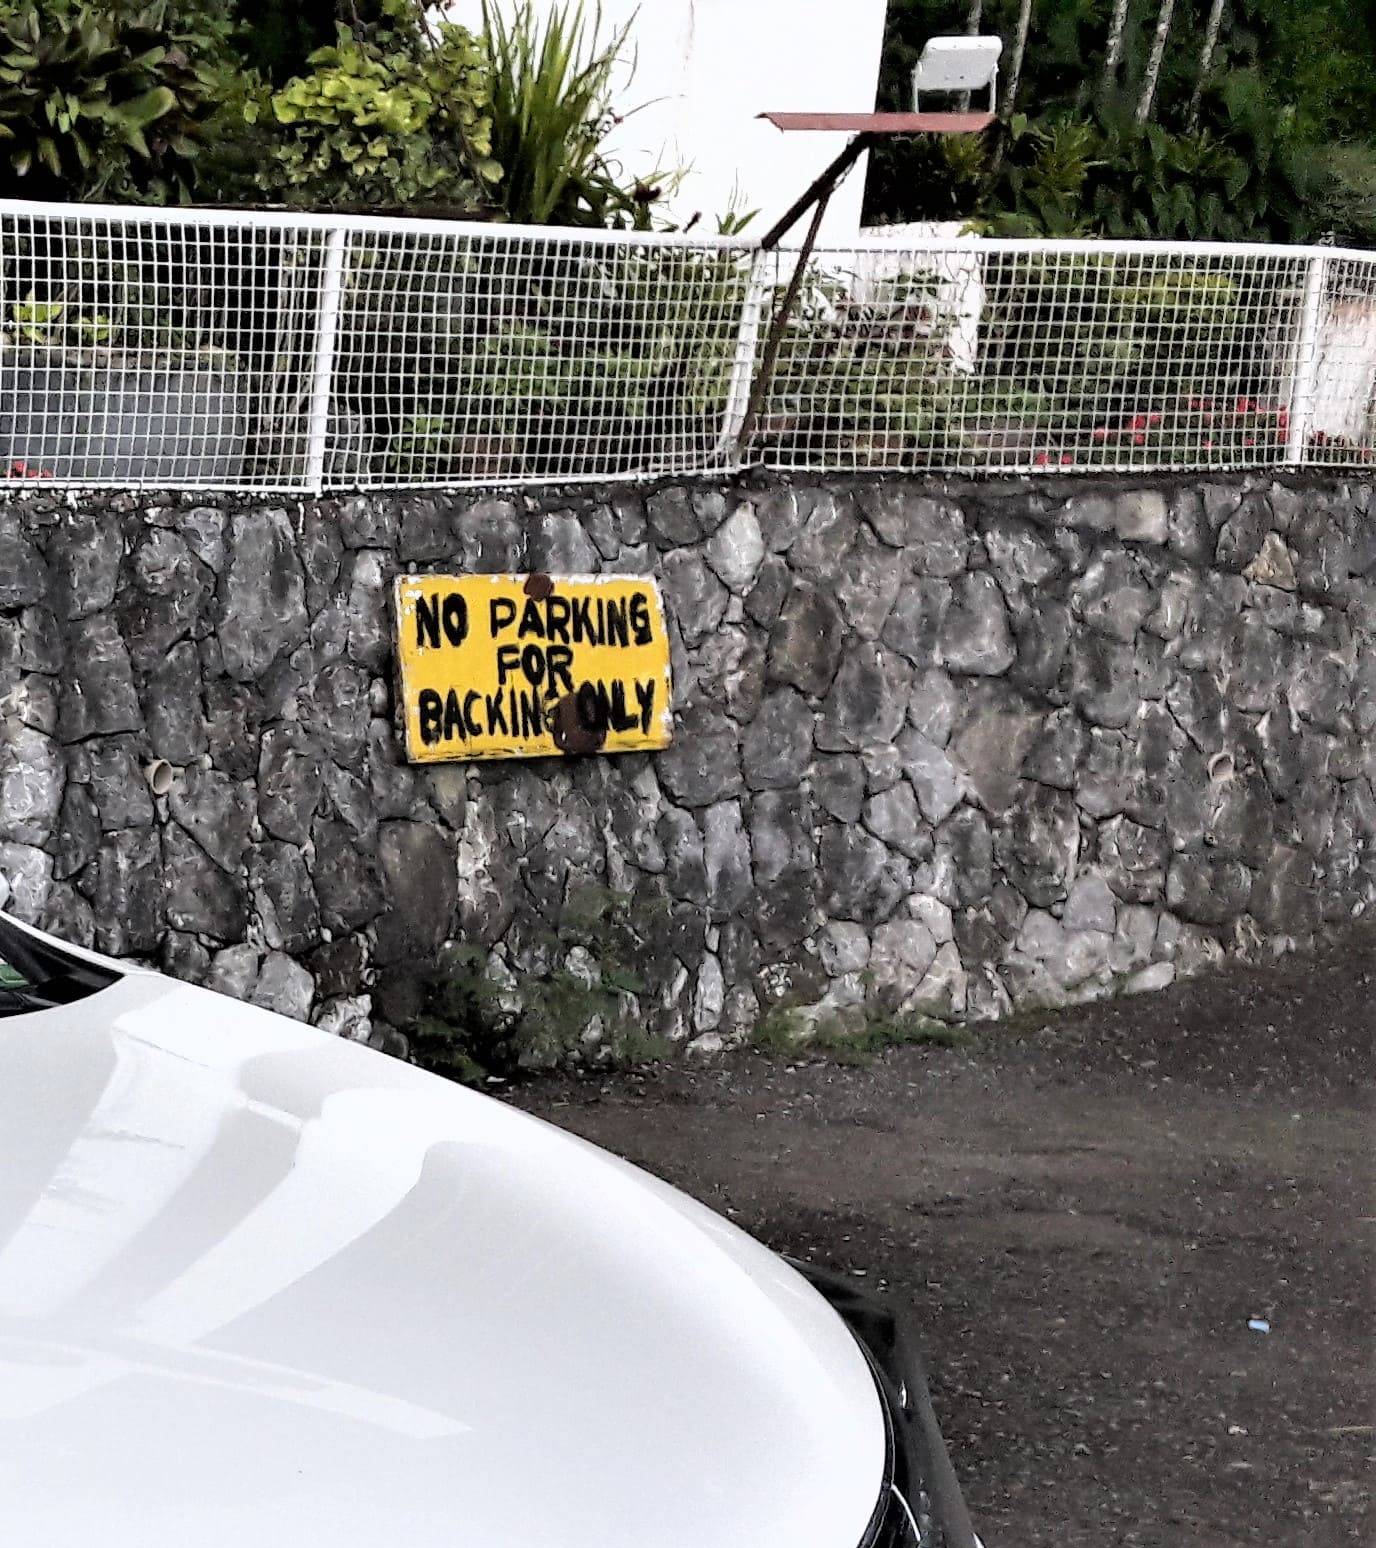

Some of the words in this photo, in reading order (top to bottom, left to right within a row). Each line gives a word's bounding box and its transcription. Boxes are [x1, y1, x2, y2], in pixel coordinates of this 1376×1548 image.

[416, 593, 468, 648] NO
[490, 592, 652, 647] PARKING
[497, 645, 575, 697] FOR
[577, 679, 655, 736] ONLY
